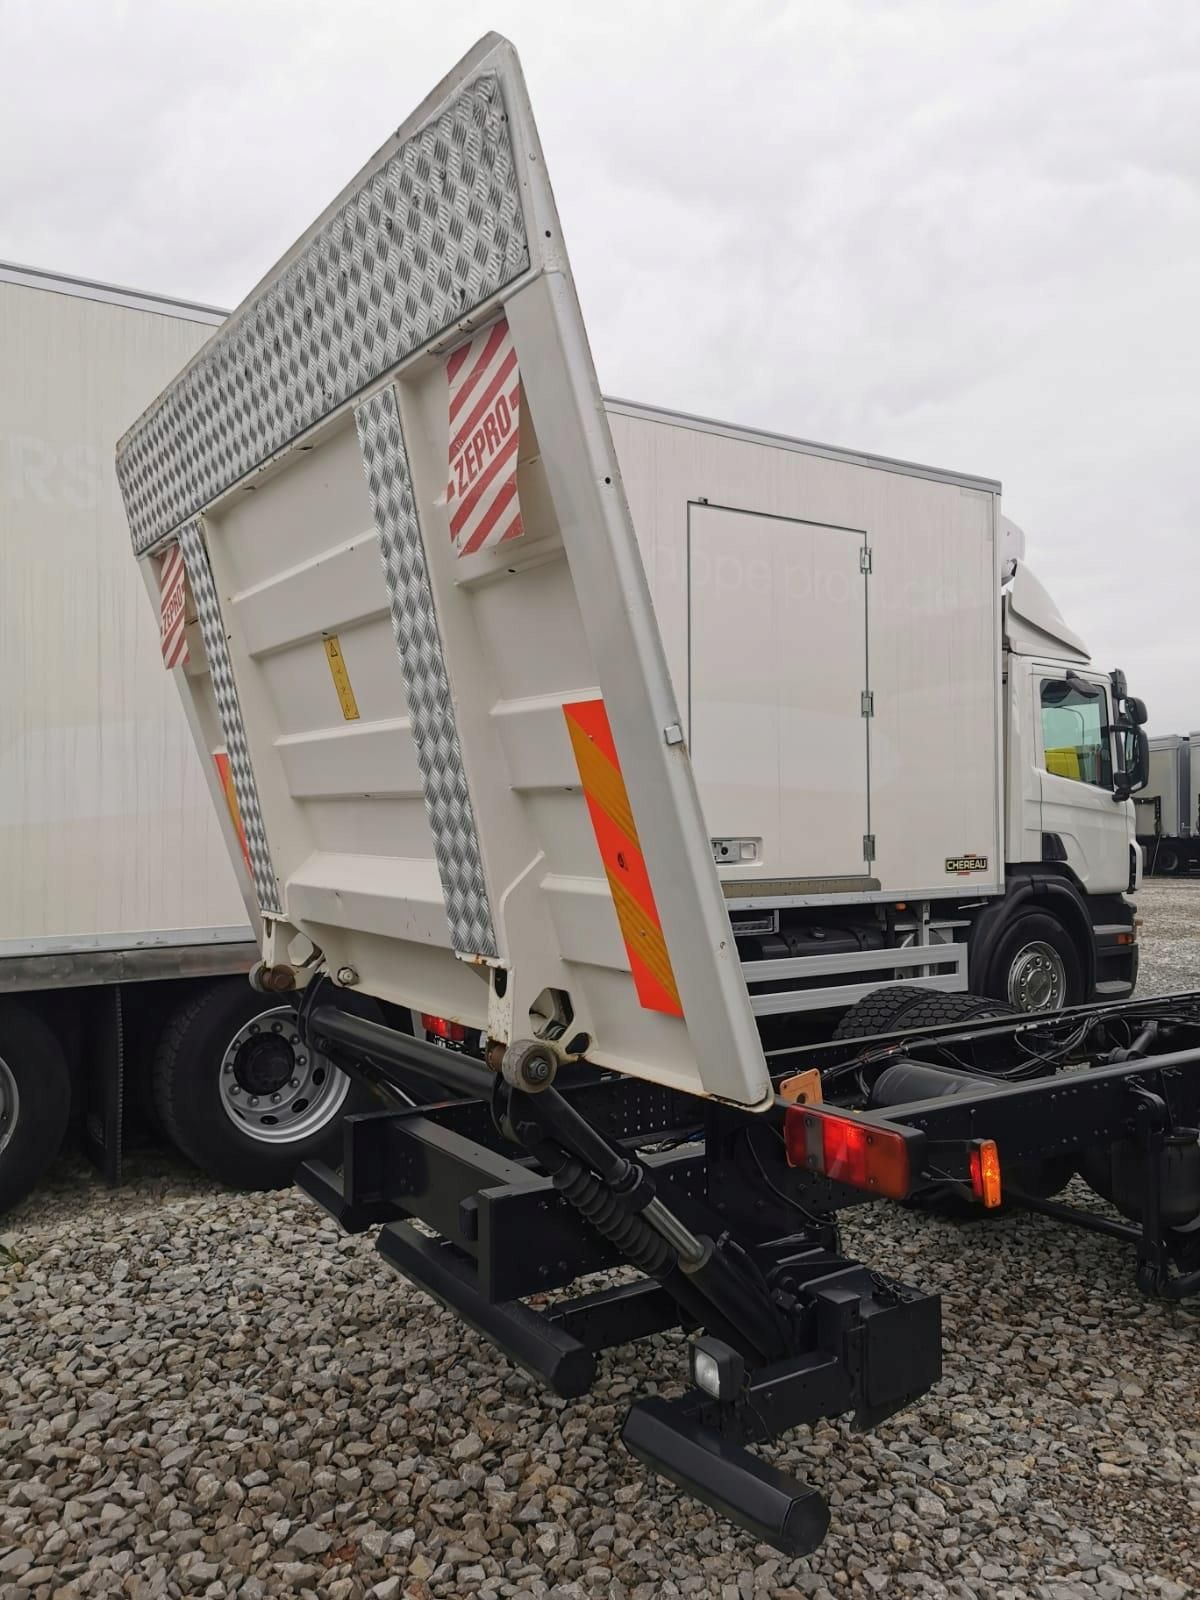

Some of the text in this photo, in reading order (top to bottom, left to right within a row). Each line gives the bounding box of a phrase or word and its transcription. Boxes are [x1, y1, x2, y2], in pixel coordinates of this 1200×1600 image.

[454, 394, 512, 498] ZEPRO
[162, 583, 183, 636] ZEPRO
[947, 859, 986, 870] CHEREAU
